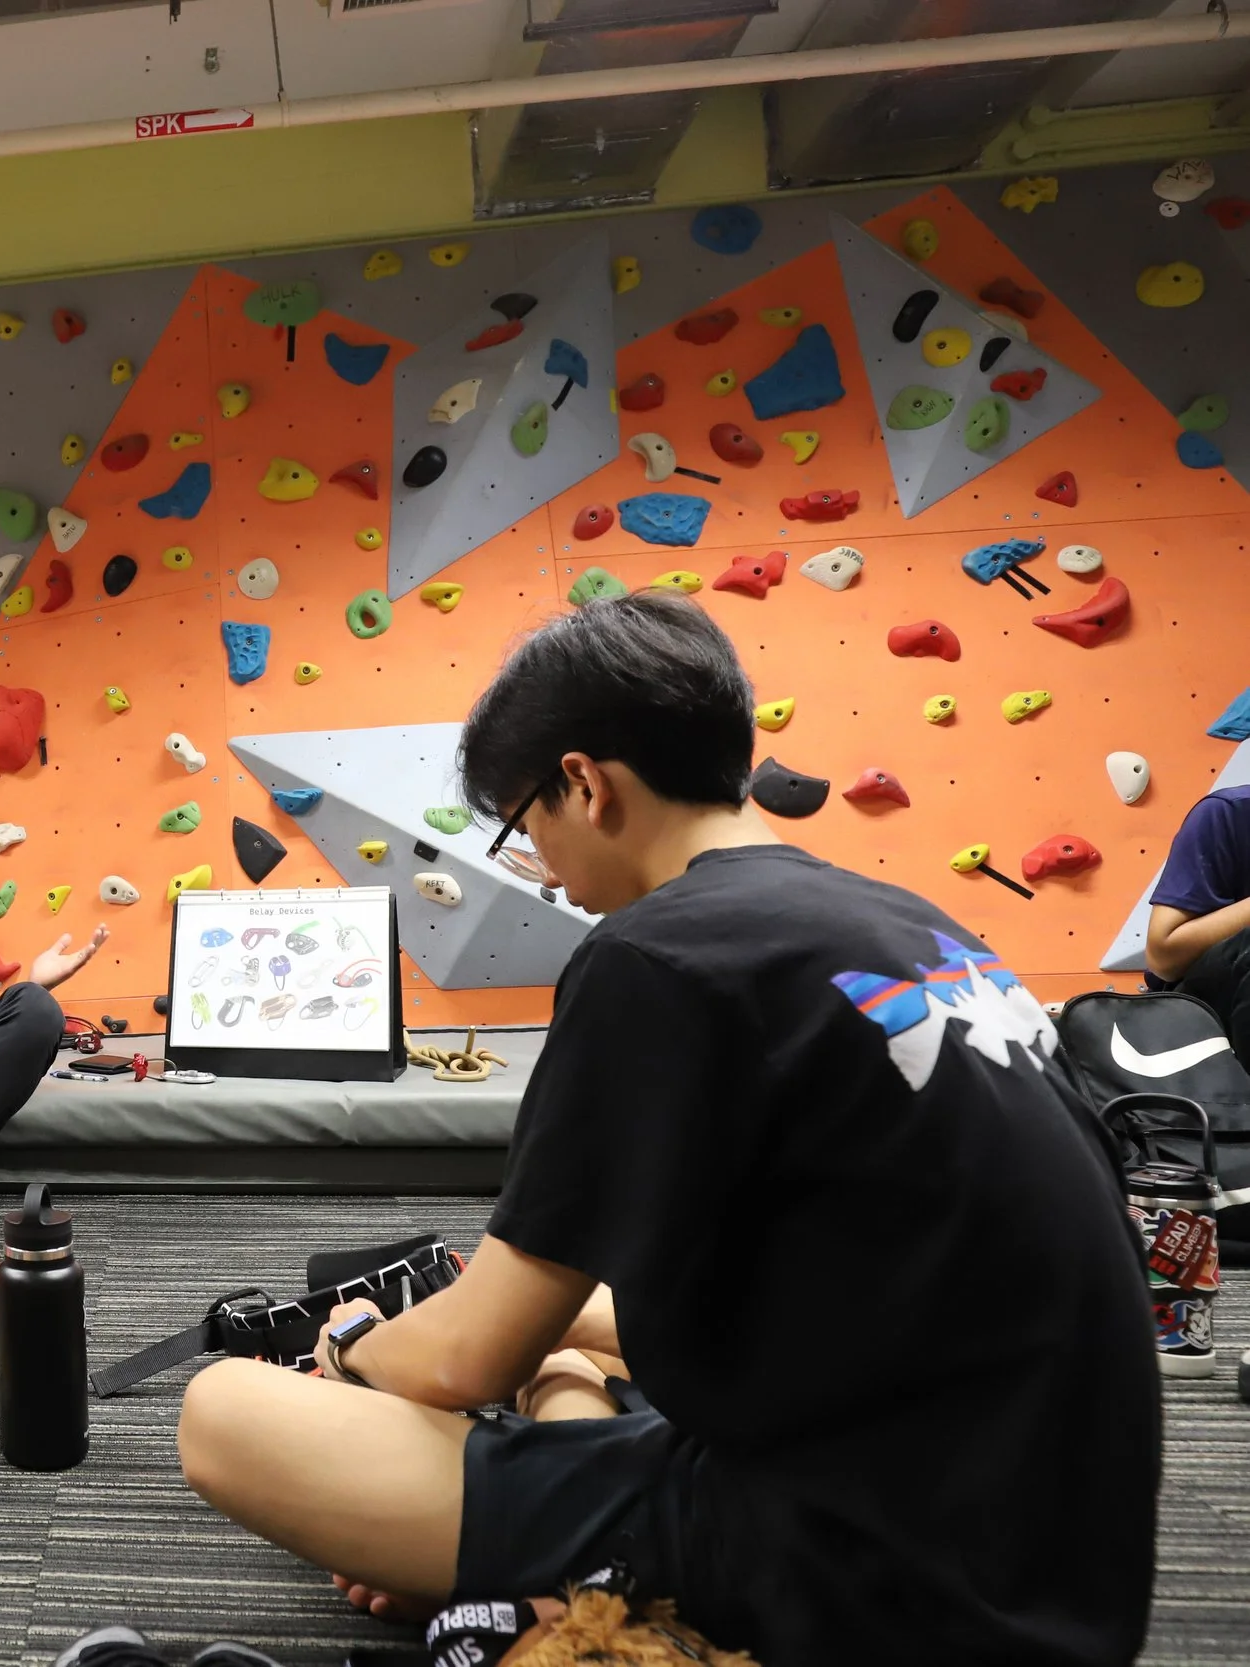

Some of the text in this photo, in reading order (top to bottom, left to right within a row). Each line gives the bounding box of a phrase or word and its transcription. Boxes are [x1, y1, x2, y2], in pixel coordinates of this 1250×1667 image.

[137, 113, 182, 137] SPK
[261, 283, 302, 306] HULK
[425, 879, 446, 888] REKT
[249, 906, 315, 917] Belay Devices
[1157, 1220, 1191, 1257] LEAD
[1176, 1223, 1202, 1262] CLIMBER
